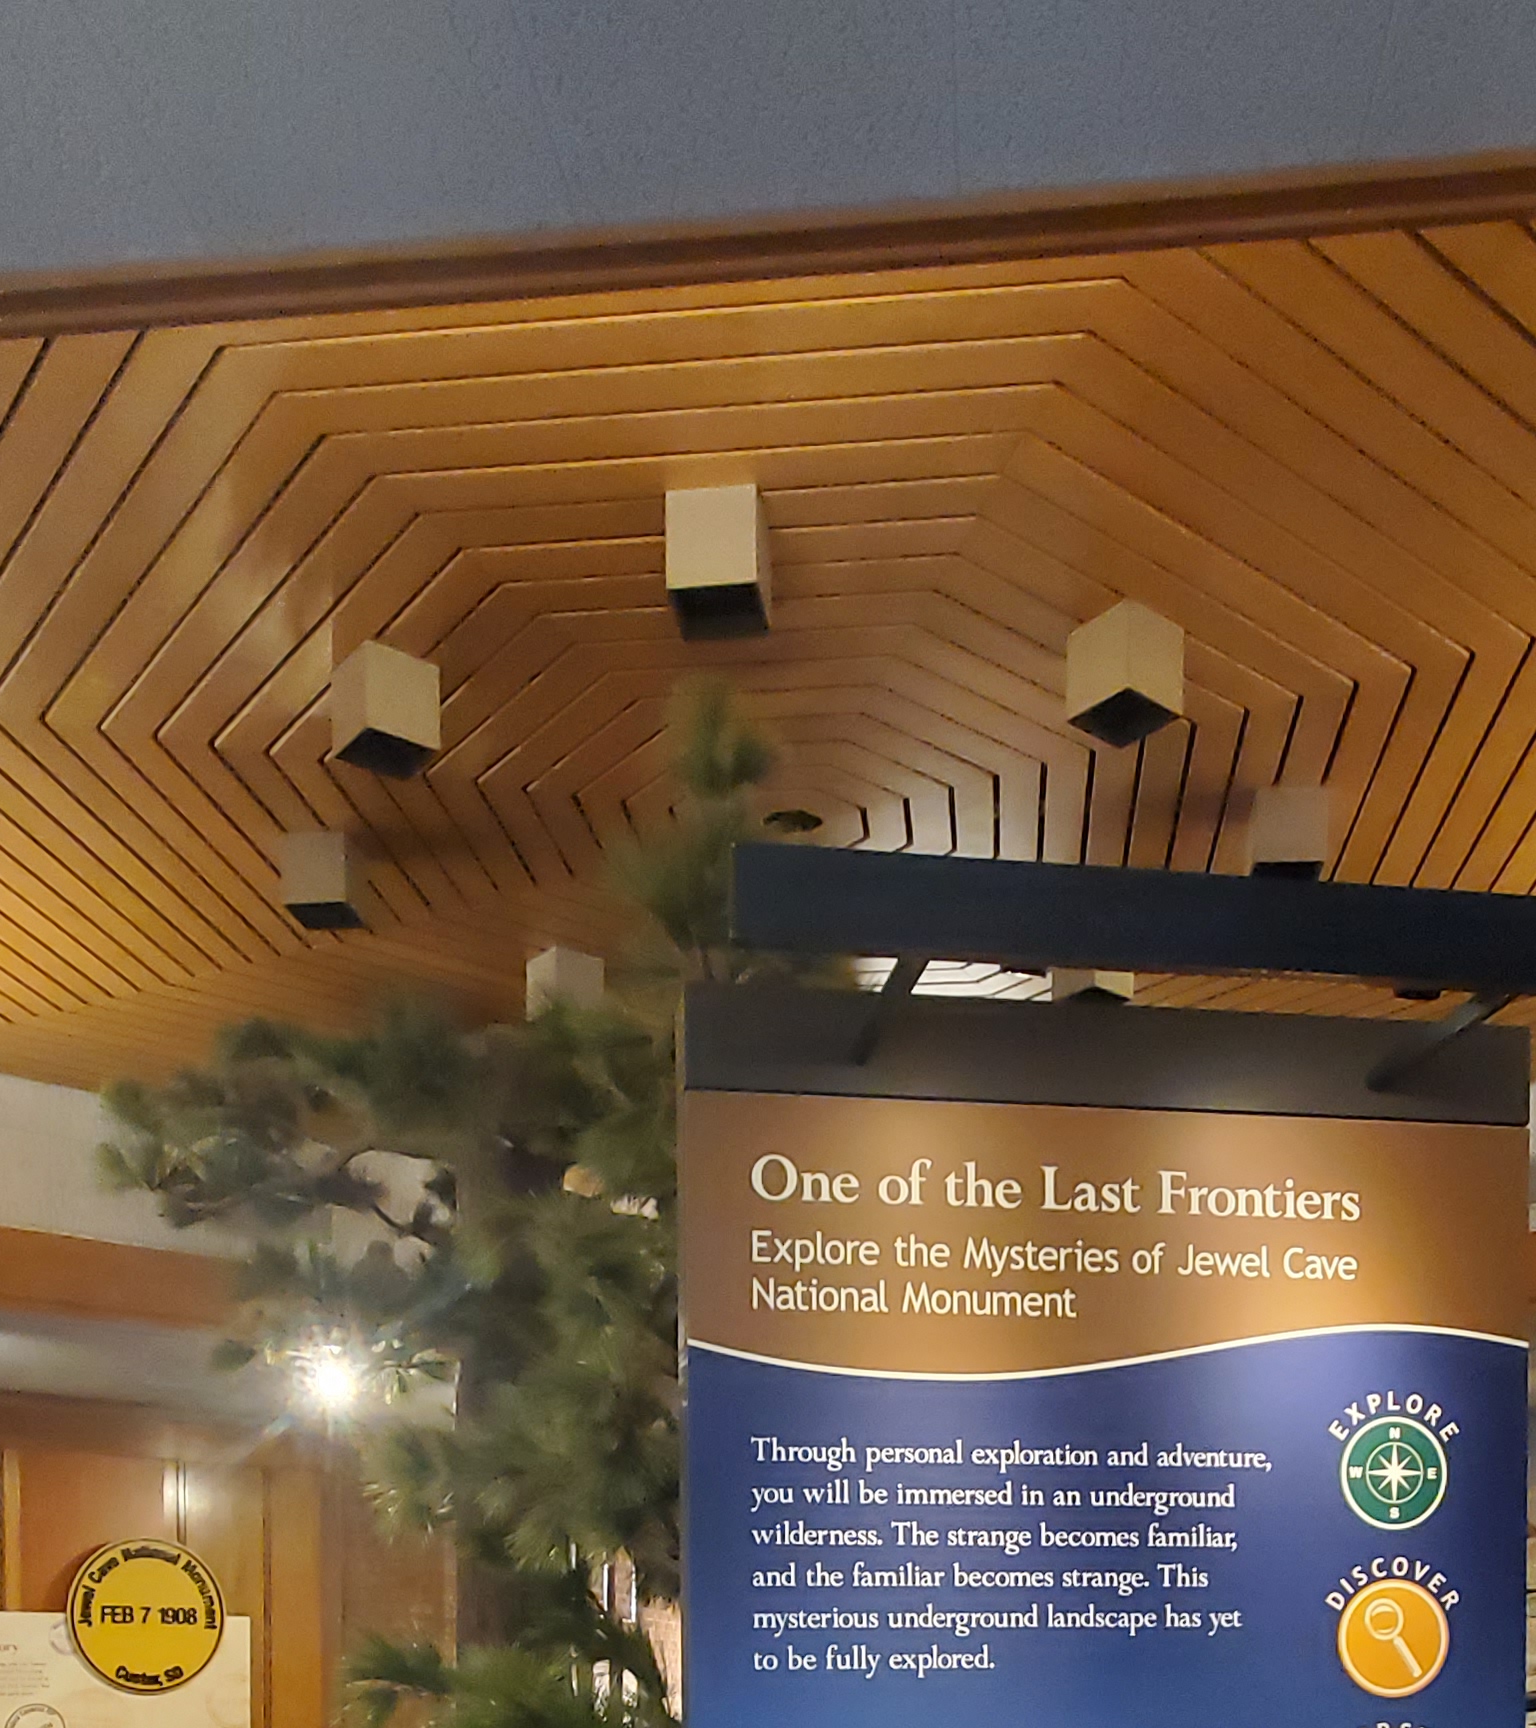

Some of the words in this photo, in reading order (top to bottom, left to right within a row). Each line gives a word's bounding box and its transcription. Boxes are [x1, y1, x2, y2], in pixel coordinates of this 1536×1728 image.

[751, 1154, 860, 1203] One
[878, 1158, 932, 1204] of
[945, 1162, 1022, 1209] the
[1041, 1166, 1141, 1213] Last
[1158, 1170, 1361, 1221] Frontiers
[751, 1229, 880, 1272] Explore
[894, 1233, 951, 1268] the
[964, 1236, 1119, 1278] Mysteries
[1133, 1242, 1166, 1274] of
[1177, 1244, 1270, 1278] Jewel
[1283, 1247, 1358, 1281] Cave
[752, 1277, 889, 1313] National
[902, 1281, 1077, 1318] Monument
[1328, 1390, 1460, 1442] EXPLORE
[1389, 1427, 1401, 1440] N
[751, 1435, 856, 1472] Through
[866, 1439, 964, 1473] personal
[972, 1440, 1099, 1474] exploration
[1107, 1442, 1149, 1467] and
[1156, 1443, 1273, 1473] adventure,
[1348, 1466, 1364, 1479] W
[1427, 1467, 1438, 1480] E
[751, 1487, 795, 1513] you
[803, 1479, 850, 1504] will
[858, 1479, 889, 1505] be
[897, 1480, 1013, 1506] immersed
[1022, 1483, 1045, 1507] in
[1052, 1490, 1082, 1507] an
[1090, 1482, 1236, 1516] underground
[751, 1520, 884, 1546] wilderness.
[891, 1520, 940, 1547] The
[947, 1527, 1032, 1556] strange
[1039, 1521, 1140, 1548] becomes
[1147, 1523, 1238, 1553] familiar,
[752, 1561, 797, 1587] and
[806, 1562, 845, 1588] the
[853, 1561, 946, 1588] familiar
[953, 1562, 1055, 1588] becomes
[1061, 1568, 1150, 1597] strange.
[1156, 1563, 1209, 1588] This
[1324, 1556, 1460, 1611] DISCOVER
[100, 1605, 135, 1624] FEB
[139, 1606, 151, 1624] 7
[157, 1607, 198, 1625] 1908
[752, 1606, 880, 1639] mysterious
[888, 1602, 1039, 1637] underground
[1047, 1603, 1158, 1637] landscape
[1164, 1604, 1202, 1628] has
[1207, 1610, 1244, 1637] yet
[753, 1652, 779, 1671] to
[787, 1645, 818, 1671] be
[825, 1643, 882, 1680] fully
[888, 1643, 996, 1679] explored.
